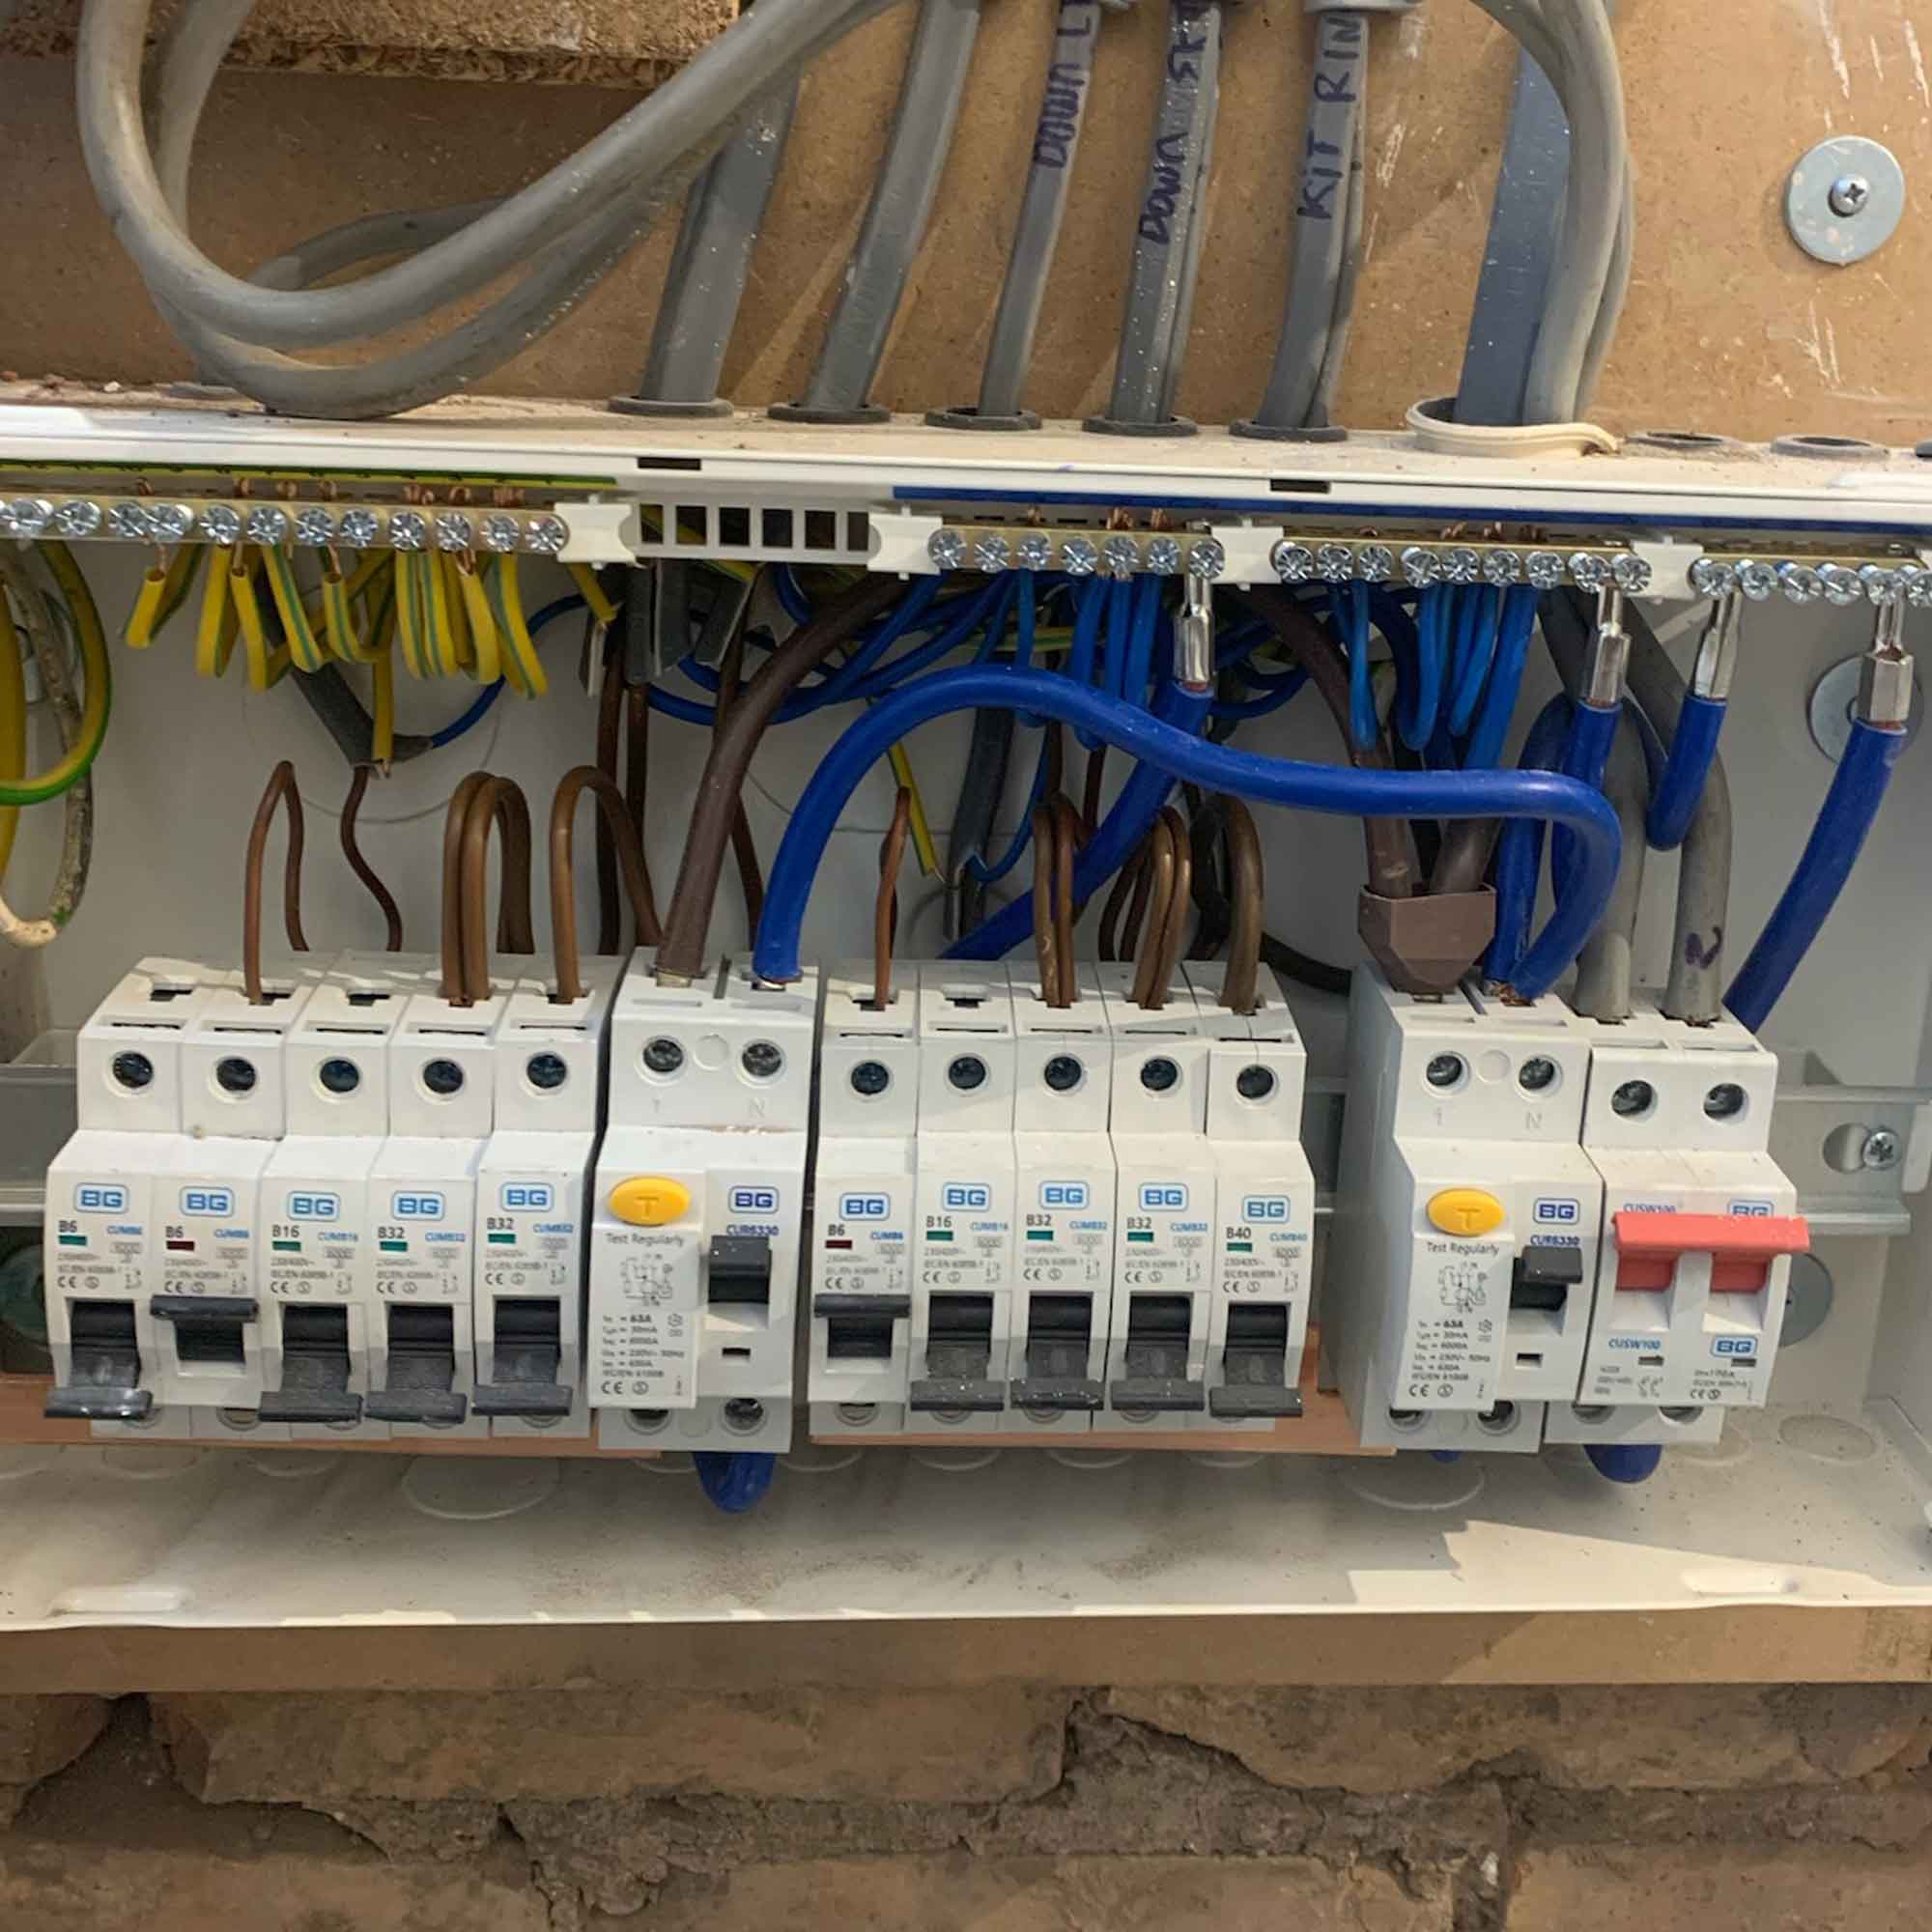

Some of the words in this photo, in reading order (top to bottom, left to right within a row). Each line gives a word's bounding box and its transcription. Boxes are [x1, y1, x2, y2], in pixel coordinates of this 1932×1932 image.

[81, 1189, 123, 1208] BG
[186, 1193, 228, 1211] BG
[506, 1189, 548, 1207] BG
[734, 1192, 773, 1208] BG
[947, 1189, 986, 1206] BG
[1045, 1187, 1084, 1204] BG
[1144, 1190, 1183, 1206] BG
[293, 1198, 335, 1215] BG
[398, 1198, 440, 1214] BG
[636, 1196, 660, 1215] T
[845, 1199, 884, 1215] BG
[1247, 1202, 1285, 1217] BG
[1539, 1204, 1575, 1219] BG
[487, 1217, 514, 1230] B32
[926, 1215, 952, 1228] B16
[1026, 1214, 1052, 1227] B32
[1126, 1217, 1152, 1230] B32
[1457, 1208, 1481, 1230] T
[59, 1220, 78, 1233] B6
[165, 1225, 185, 1237] B6
[271, 1224, 300, 1237] B16
[378, 1226, 405, 1239] B32
[828, 1224, 845, 1236] B6
[1226, 1227, 1252, 1239] B40
[606, 1234, 629, 1245] Test
[632, 1234, 684, 1247] Regularly
[1427, 1242, 1447, 1253] Test
[1451, 1242, 1499, 1256] Regularly
[1607, 1338, 1662, 1350] CUSW100
[1716, 1340, 1752, 1353] BG
